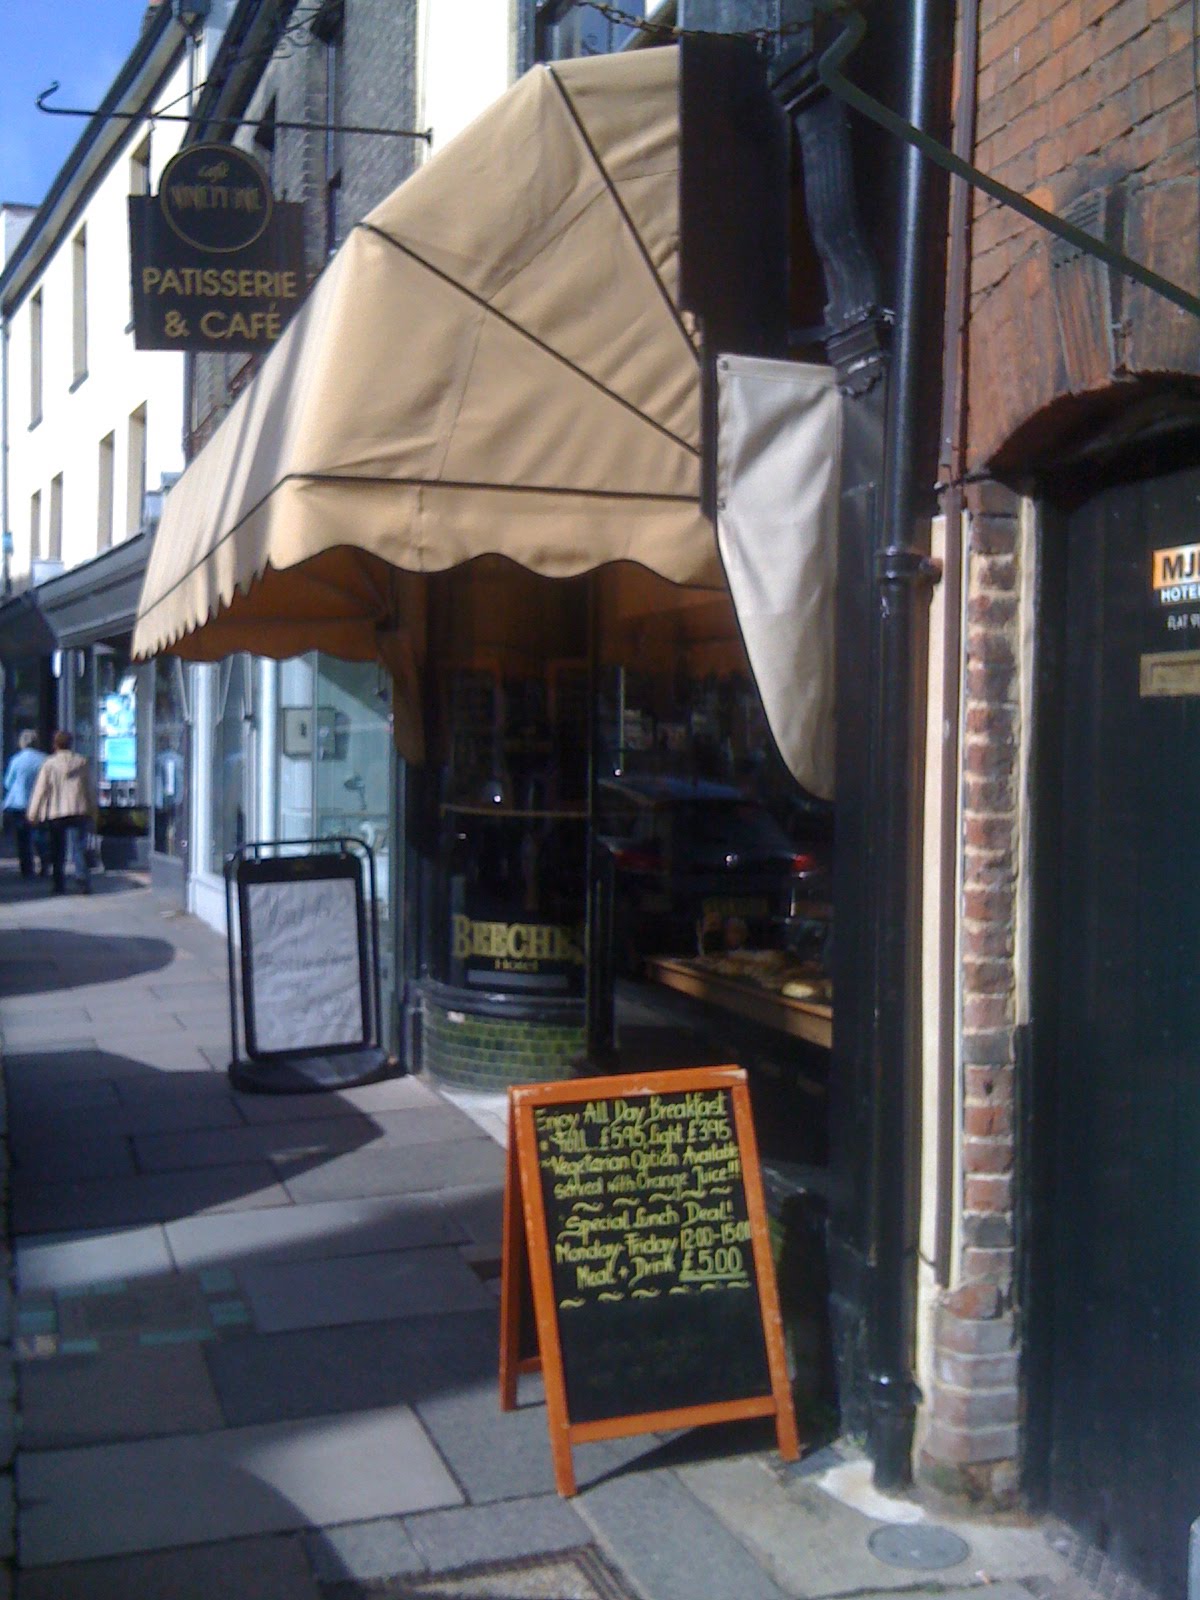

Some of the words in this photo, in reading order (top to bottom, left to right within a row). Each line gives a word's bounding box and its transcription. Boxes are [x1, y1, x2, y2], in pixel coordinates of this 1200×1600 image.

[142, 266, 297, 298] PATISSERIE
[164, 309, 191, 338] &
[200, 302, 282, 339] CAFÉ
[583, 1100, 610, 1124] All
[611, 1099, 646, 1127] Day
[645, 1090, 728, 1124] Breakfast
[631, 1149, 679, 1173] Option
[682, 1141, 739, 1167] Available
[636, 1172, 690, 1198] Orange
[559, 1209, 631, 1246] Special
[632, 1203, 680, 1228] Lunch
[576, 1261, 617, 1290] Meal
[629, 1253, 676, 1287] Drink
